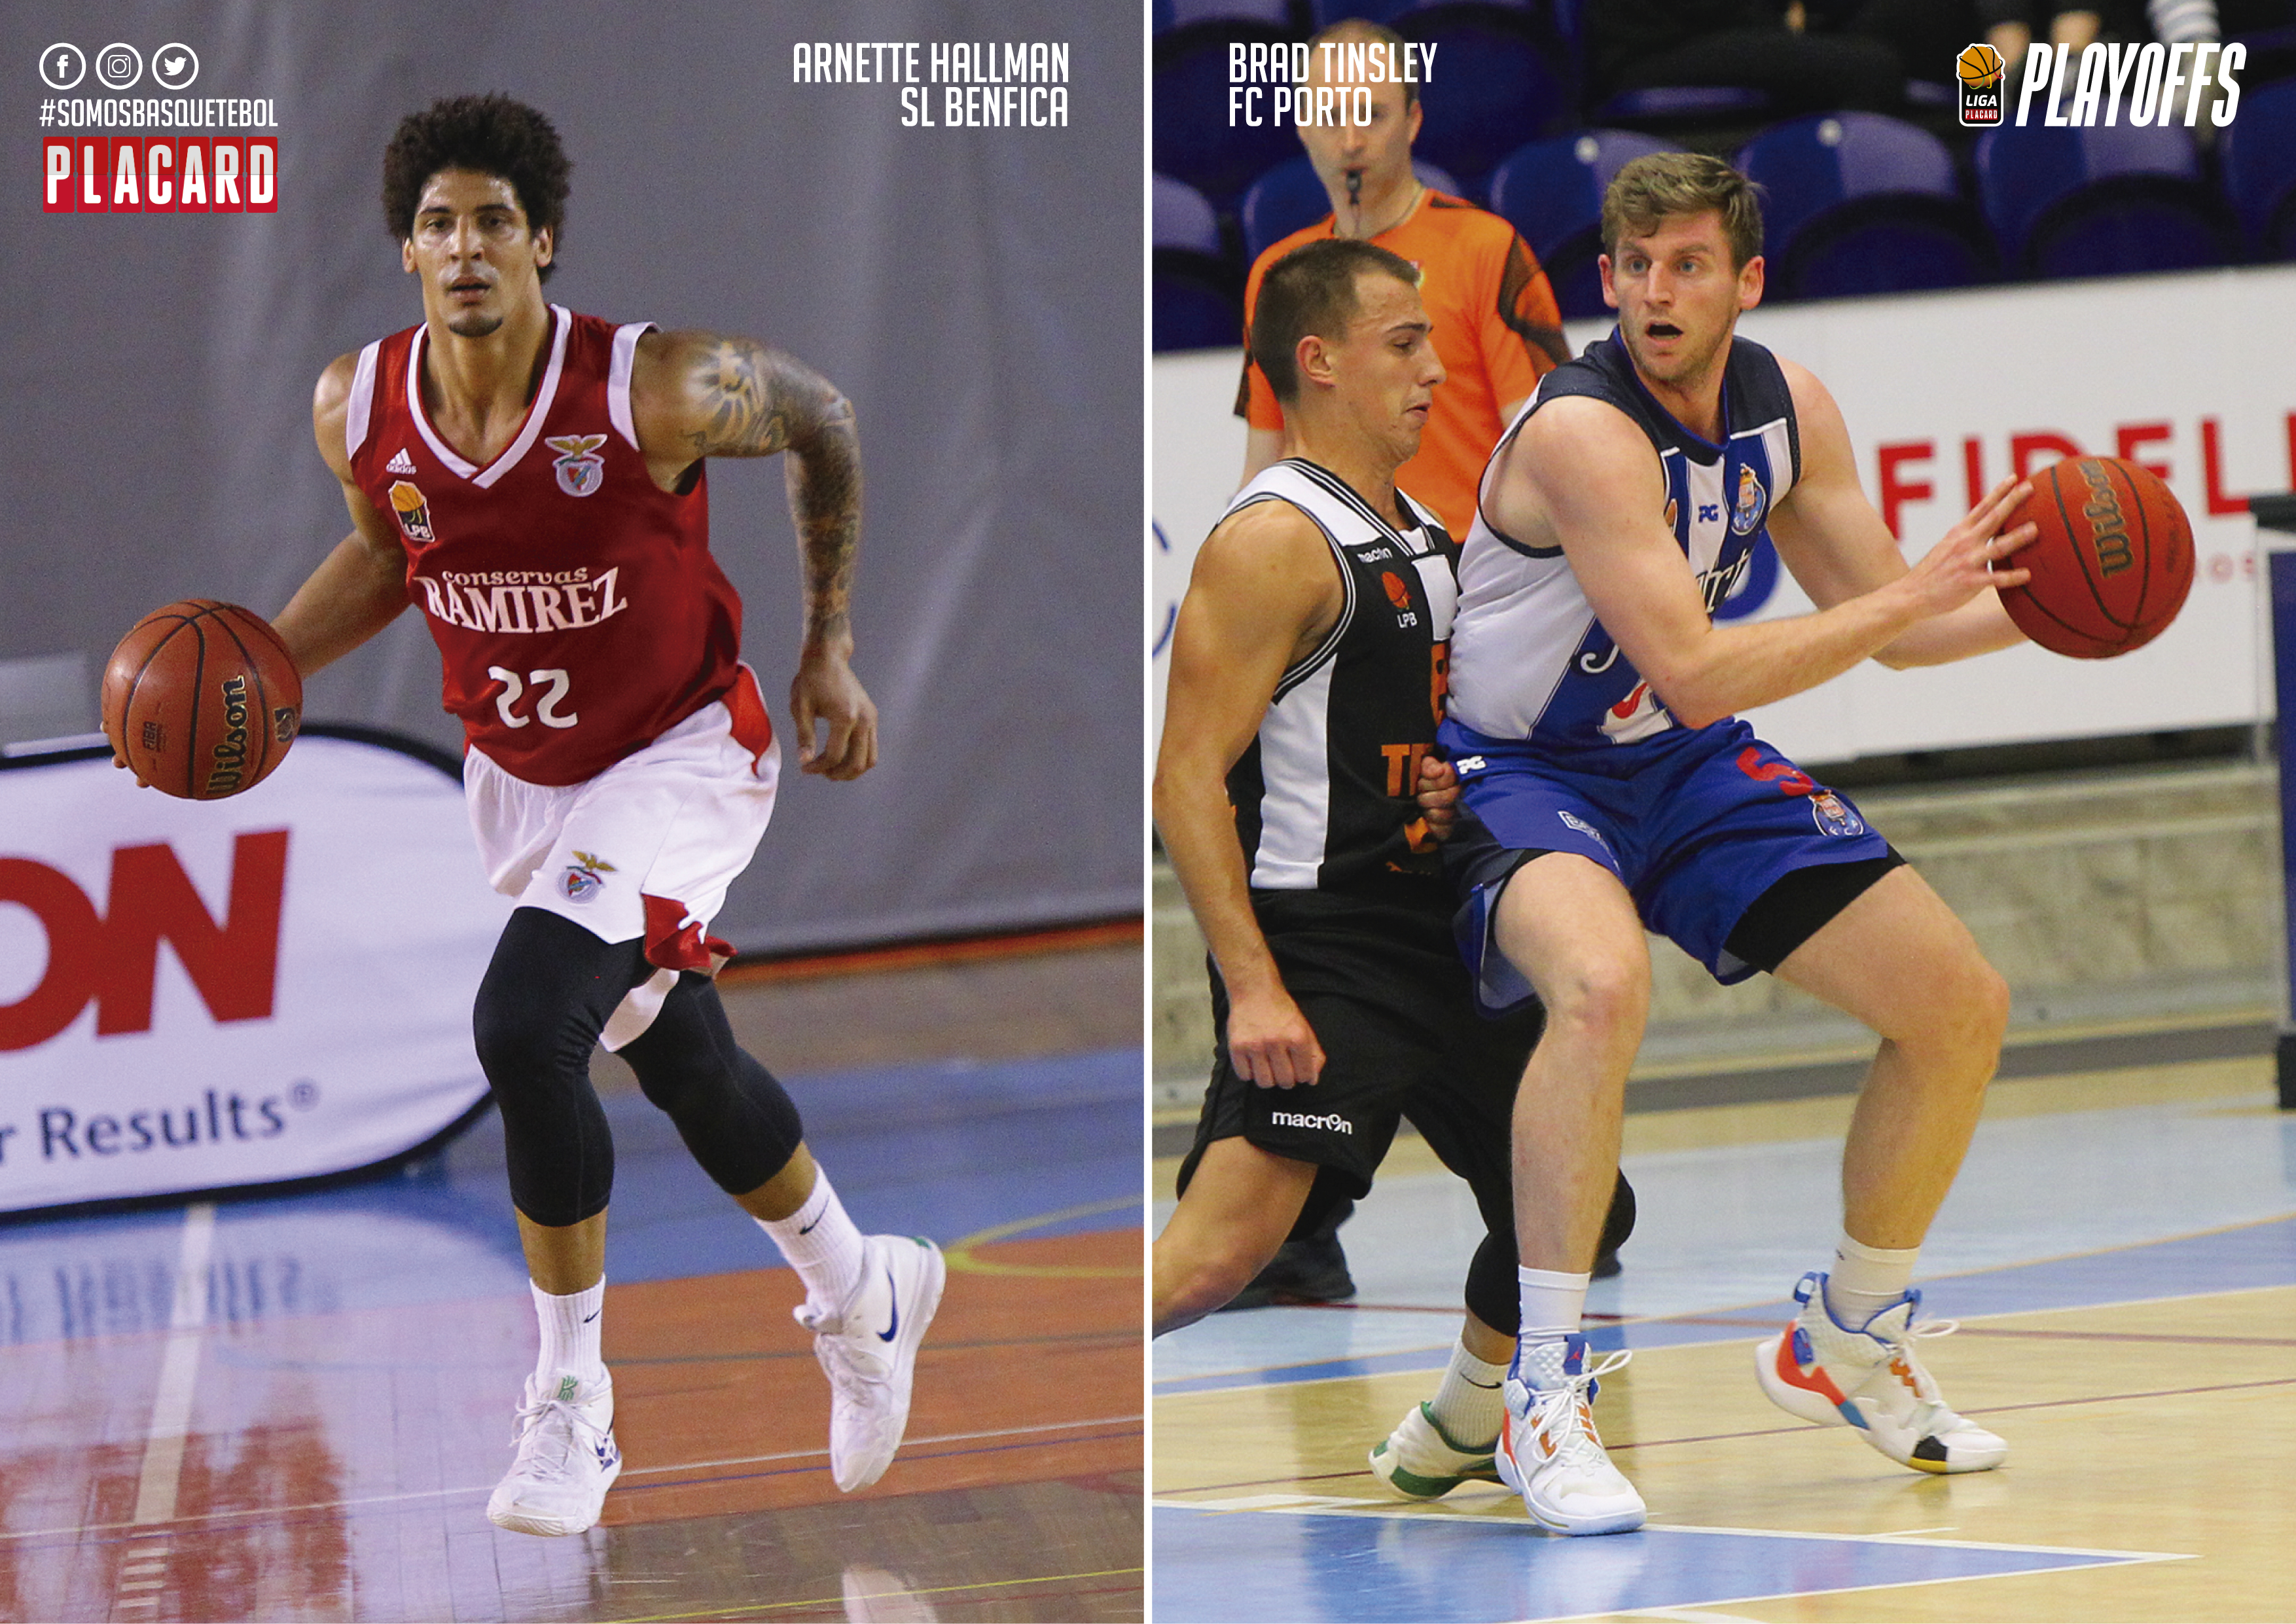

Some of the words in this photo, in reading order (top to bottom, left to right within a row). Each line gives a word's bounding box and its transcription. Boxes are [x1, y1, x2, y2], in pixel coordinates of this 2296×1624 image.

[386, 463, 417, 475] adidas
[404, 523, 432, 539] LPB
[442, 566, 588, 585] conservas
[413, 566, 628, 633] RAMIREZ
[1397, 611, 1418, 628] LPB
[488, 666, 579, 729] 22
[206, 675, 248, 794] Wilson
[1272, 1111, 1352, 1134] macron
